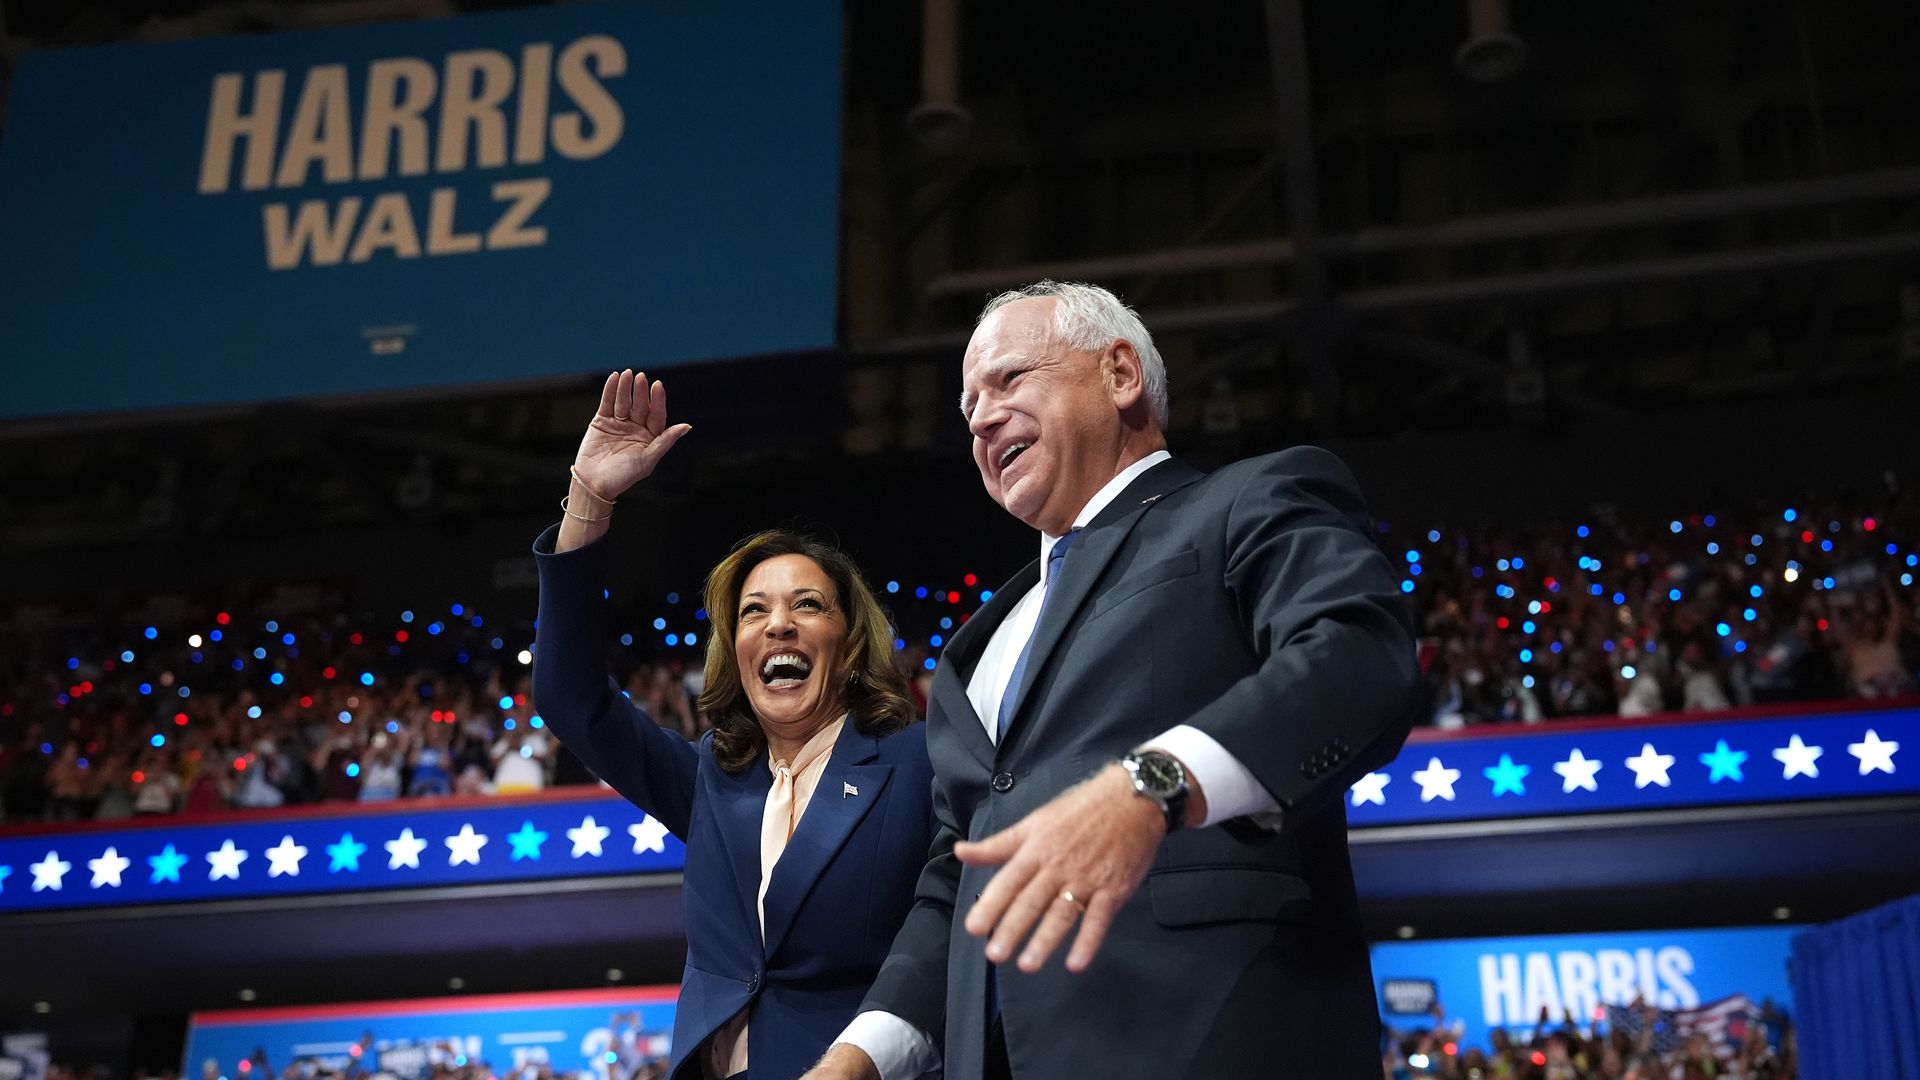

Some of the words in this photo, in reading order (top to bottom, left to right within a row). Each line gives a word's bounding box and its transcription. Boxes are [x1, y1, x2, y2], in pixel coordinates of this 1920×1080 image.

[199, 35, 628, 193] HARRIS
[263, 179, 551, 270] WALZ
[1479, 946, 1699, 1026] HARRIS
